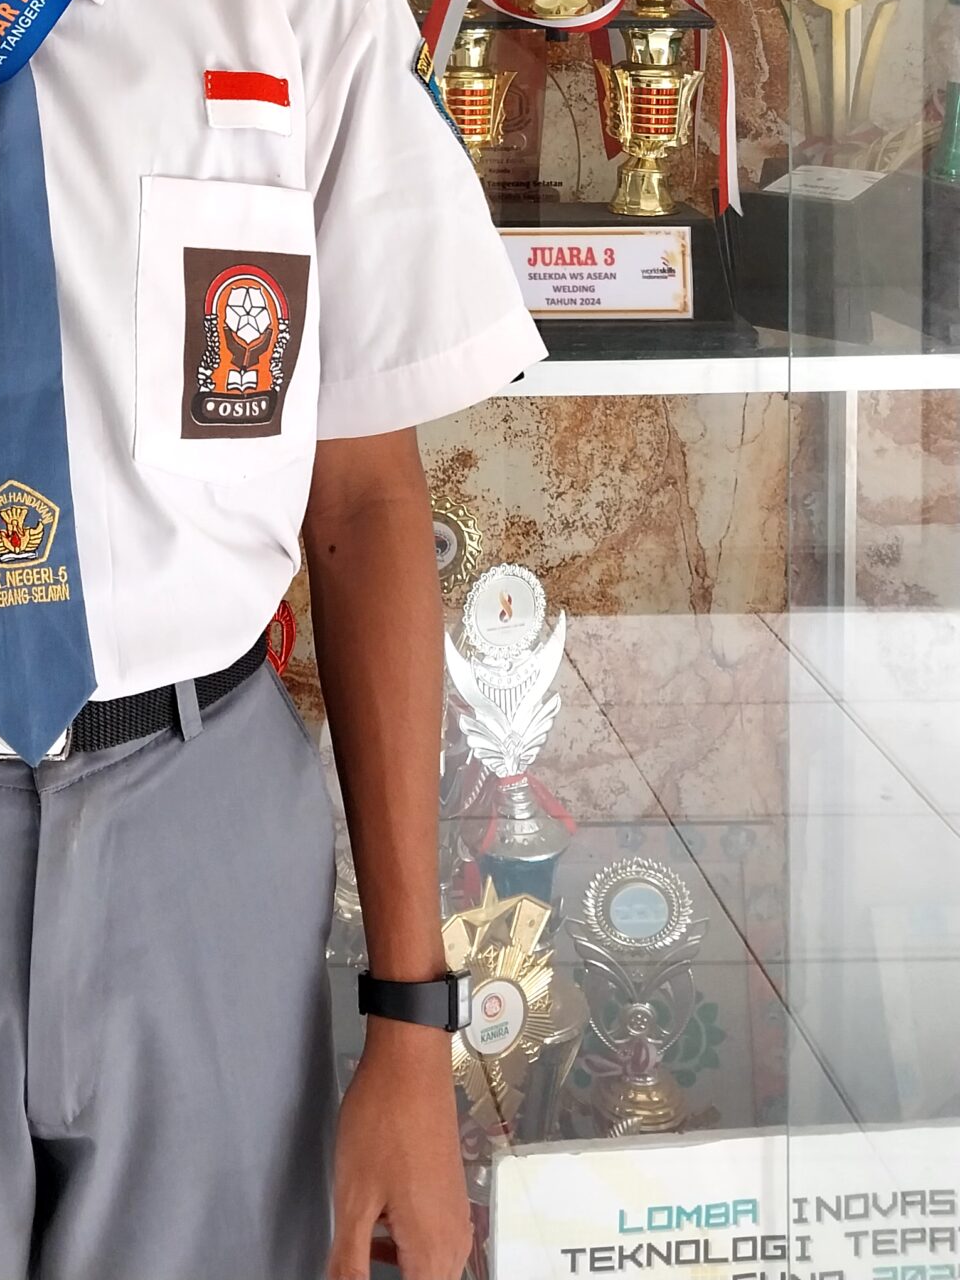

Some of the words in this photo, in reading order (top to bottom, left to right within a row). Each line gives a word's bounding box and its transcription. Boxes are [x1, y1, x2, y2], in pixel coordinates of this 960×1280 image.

[527, 247, 597, 267] JUARA
[604, 247, 615, 266] 3
[528, 272, 568, 281] SELEKDA
[569, 272, 585, 281] WS
[586, 272, 617, 280] ASEAN
[552, 284, 595, 293] WELDING
[545, 298, 577, 306] TAHUN
[579, 298, 601, 306] 2024
[218, 402, 260, 417] OSIS
[5, 567, 53, 587] NEGERI
[58, 565, 68, 582] 5
[32, 583, 70, 602] SELATAN
[618, 1198, 759, 1233] LOMBA
[792, 1189, 956, 1224] INOVAS
[561, 1234, 812, 1273] TEKNOLOGI
[844, 1226, 960, 1257] TEPA
